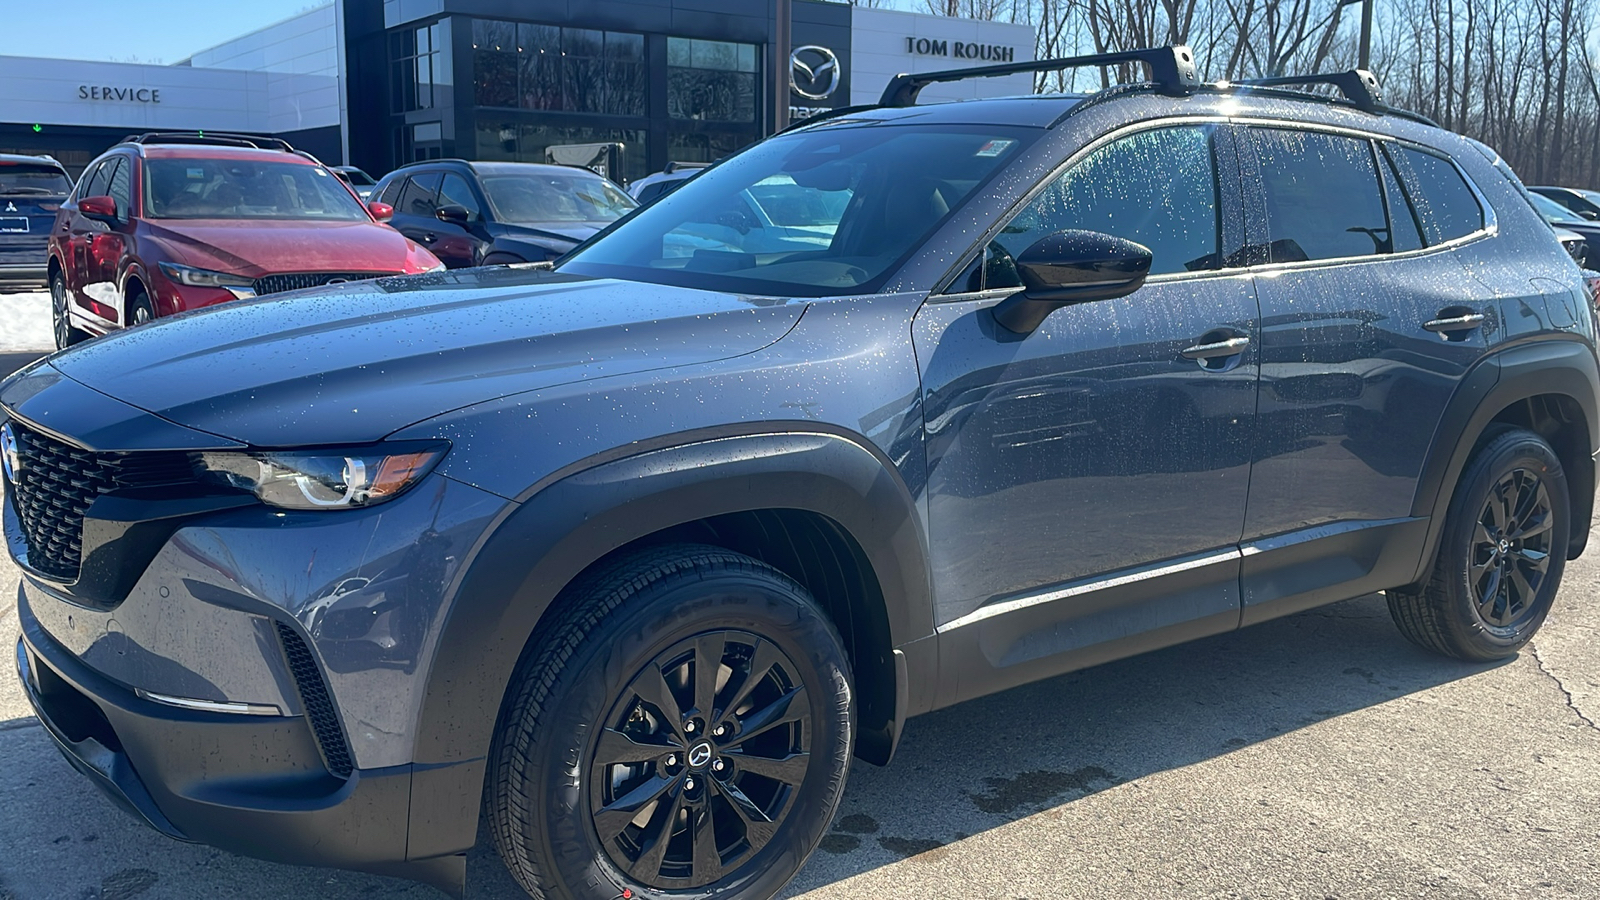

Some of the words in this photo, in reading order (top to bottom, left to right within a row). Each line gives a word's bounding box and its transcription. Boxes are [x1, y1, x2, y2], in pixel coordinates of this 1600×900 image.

[905, 37, 947, 56] TOM
[954, 41, 1014, 62] ROUSH
[79, 85, 161, 103] SERVICE
